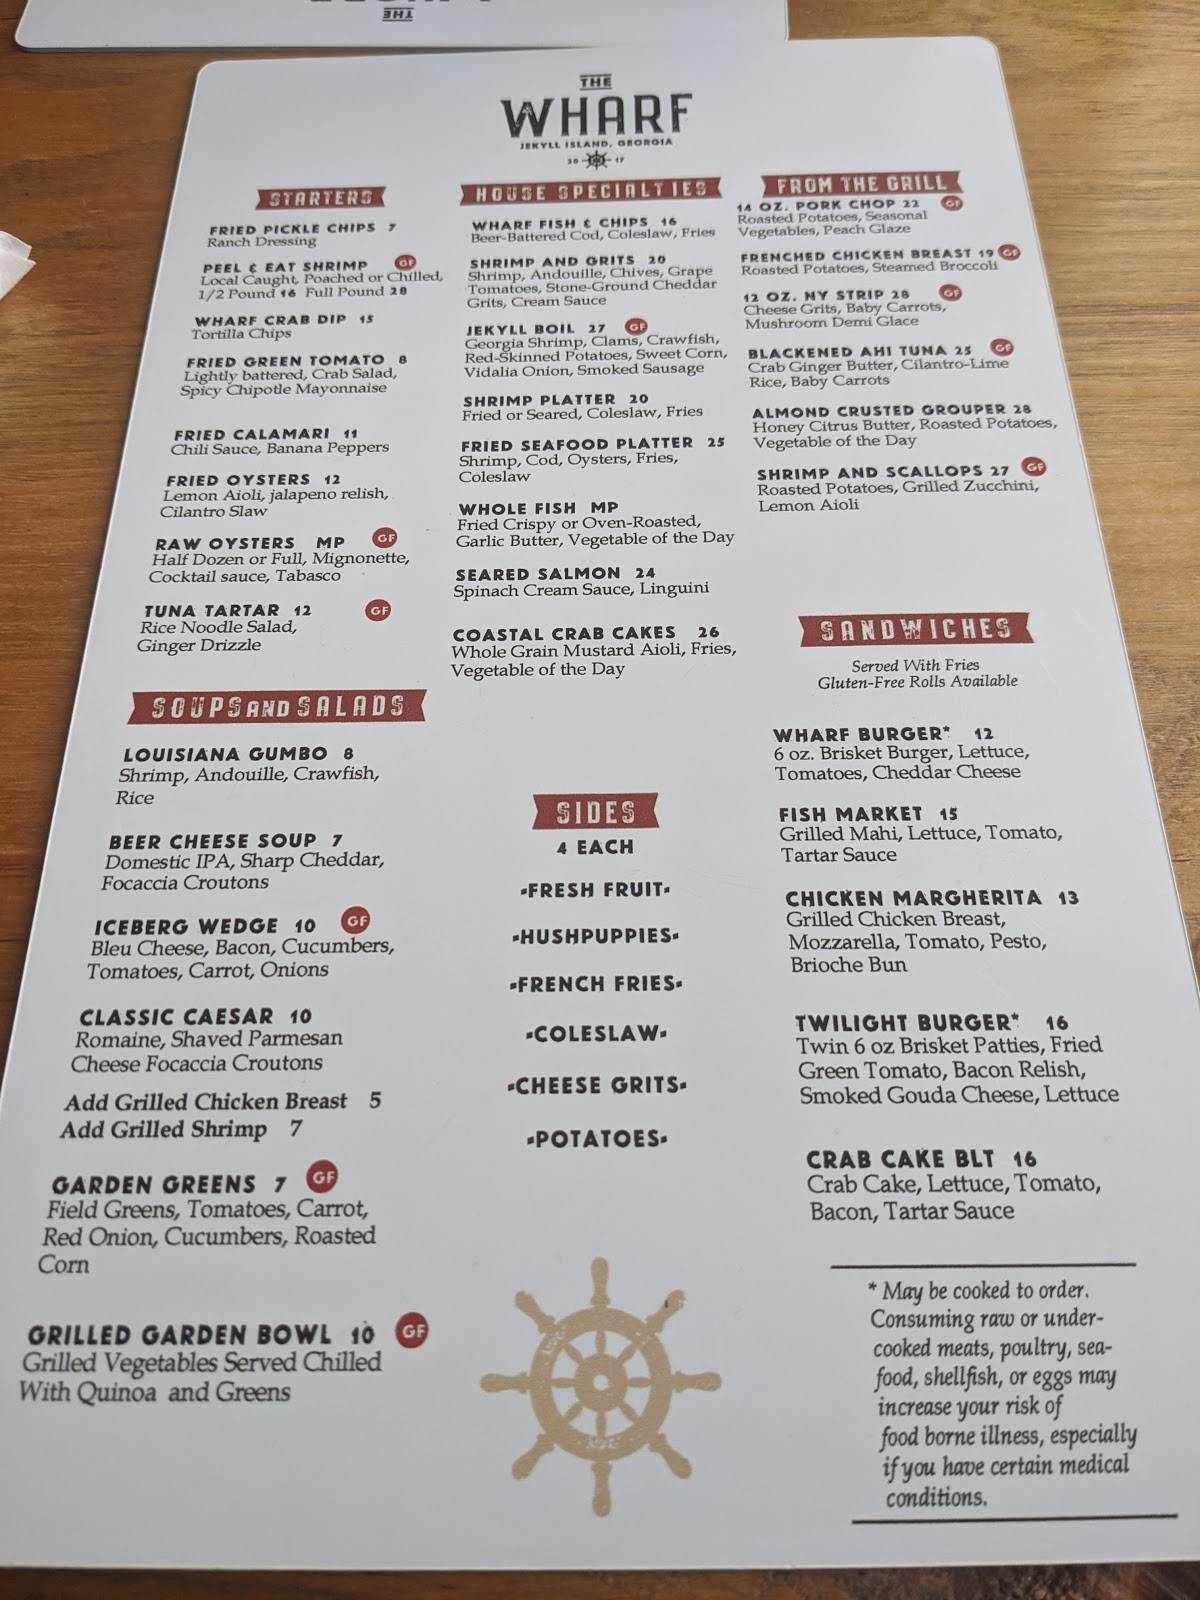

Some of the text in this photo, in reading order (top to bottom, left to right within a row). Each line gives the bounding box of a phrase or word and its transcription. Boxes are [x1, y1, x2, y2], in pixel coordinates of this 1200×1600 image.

[383, 10, 413, 19] THE
[580, 76, 612, 88] THE
[500, 93, 692, 138] WHARF
[520, 138, 672, 150] JEKYLL ISLAND, GEORGIA
[777, 173, 947, 194] FROM THE GRILL
[270, 190, 372, 207] STARTERS
[476, 184, 545, 202] HOUSE
[737, 199, 920, 212] 14 OZ. PORK CHOP 22
[472, 220, 532, 232] WHARF
[540, 219, 575, 229] FISH
[599, 217, 648, 228] CHIPS
[661, 217, 677, 226] 16
[738, 210, 928, 224] Roasted Potatoes, Seasonal
[210, 222, 396, 236] FRIED PICKLE CHIPS 7
[472, 228, 715, 243] Beer-Battered Cod, Coleslaw, Fries
[208, 236, 317, 248] Ranch Dressing
[741, 248, 994, 263] FRENCHED CHICKEN BREAST 19
[195, 314, 374, 327] WHARF CRAB DIP 15
[629, 323, 646, 332] GF
[192, 328, 292, 341] Tortilla Chips
[466, 323, 606, 336] JEKYLL BOIL 27
[748, 345, 971, 359] BLACKENED AHI TUNA 25
[995, 343, 1012, 352] GF
[750, 374, 890, 390] Rice, Baby Carrots
[464, 393, 648, 407] SHRIMP PLATTER 20
[174, 428, 357, 441] FRIED CALAMARI 11
[171, 442, 389, 456] Chili Sauce, Banana Peppers
[757, 465, 1009, 481] SHRIMP AND SCALLOPS 27
[1026, 462, 1045, 472] GF
[459, 502, 618, 516] WHOLE FISH MP
[156, 537, 344, 551] RAW OYSTERS MP
[378, 534, 395, 544] GF
[456, 567, 656, 581] SEARED SALMON 24
[454, 582, 709, 602] Spinach Cream Sauce, Linguini
[145, 604, 312, 618] TUNA TARTAR 12
[370, 606, 389, 616] GF
[140, 620, 297, 634] Rice Noodle Salad,
[821, 617, 1010, 641] SANDWICHES
[137, 638, 262, 656] Ginger Drizzle
[852, 658, 980, 673] Served With Fries
[818, 674, 1018, 689] Gluten-Free Rolls Available
[152, 695, 404, 718] SOUPS AND SALADS
[124, 746, 354, 762] LOUISIANA GUMBO 8
[556, 800, 635, 824] SIDES
[780, 806, 958, 823] FISH MARKET 15
[556, 839, 633, 855] 4 EACH
[781, 847, 897, 862] Tartar Sauce
[786, 889, 1079, 908] CHICKEN MARGHERITA 13
[94, 918, 316, 936] ICEBERG WEDGE 10
[347, 915, 368, 928] GF
[790, 956, 908, 973] Brioche Bun
[80, 1008, 312, 1027] CLASSIC CAESAR 10
[795, 1014, 907, 1032] TWILIGHT
[1046, 1016, 1068, 1030] 16
[59, 1119, 303, 1142] Add Grilled Shrimp 7
[806, 1148, 1037, 1169] CRAB CAKE BLT 16
[871, 1306, 1104, 1334] Consuming raw or under-
[28, 1324, 375, 1346] GRILLED GARDEN BOWL 10
[401, 1324, 426, 1338] GF
[878, 1394, 1064, 1422] increase your risk of
[886, 1486, 987, 1508] conditions.
